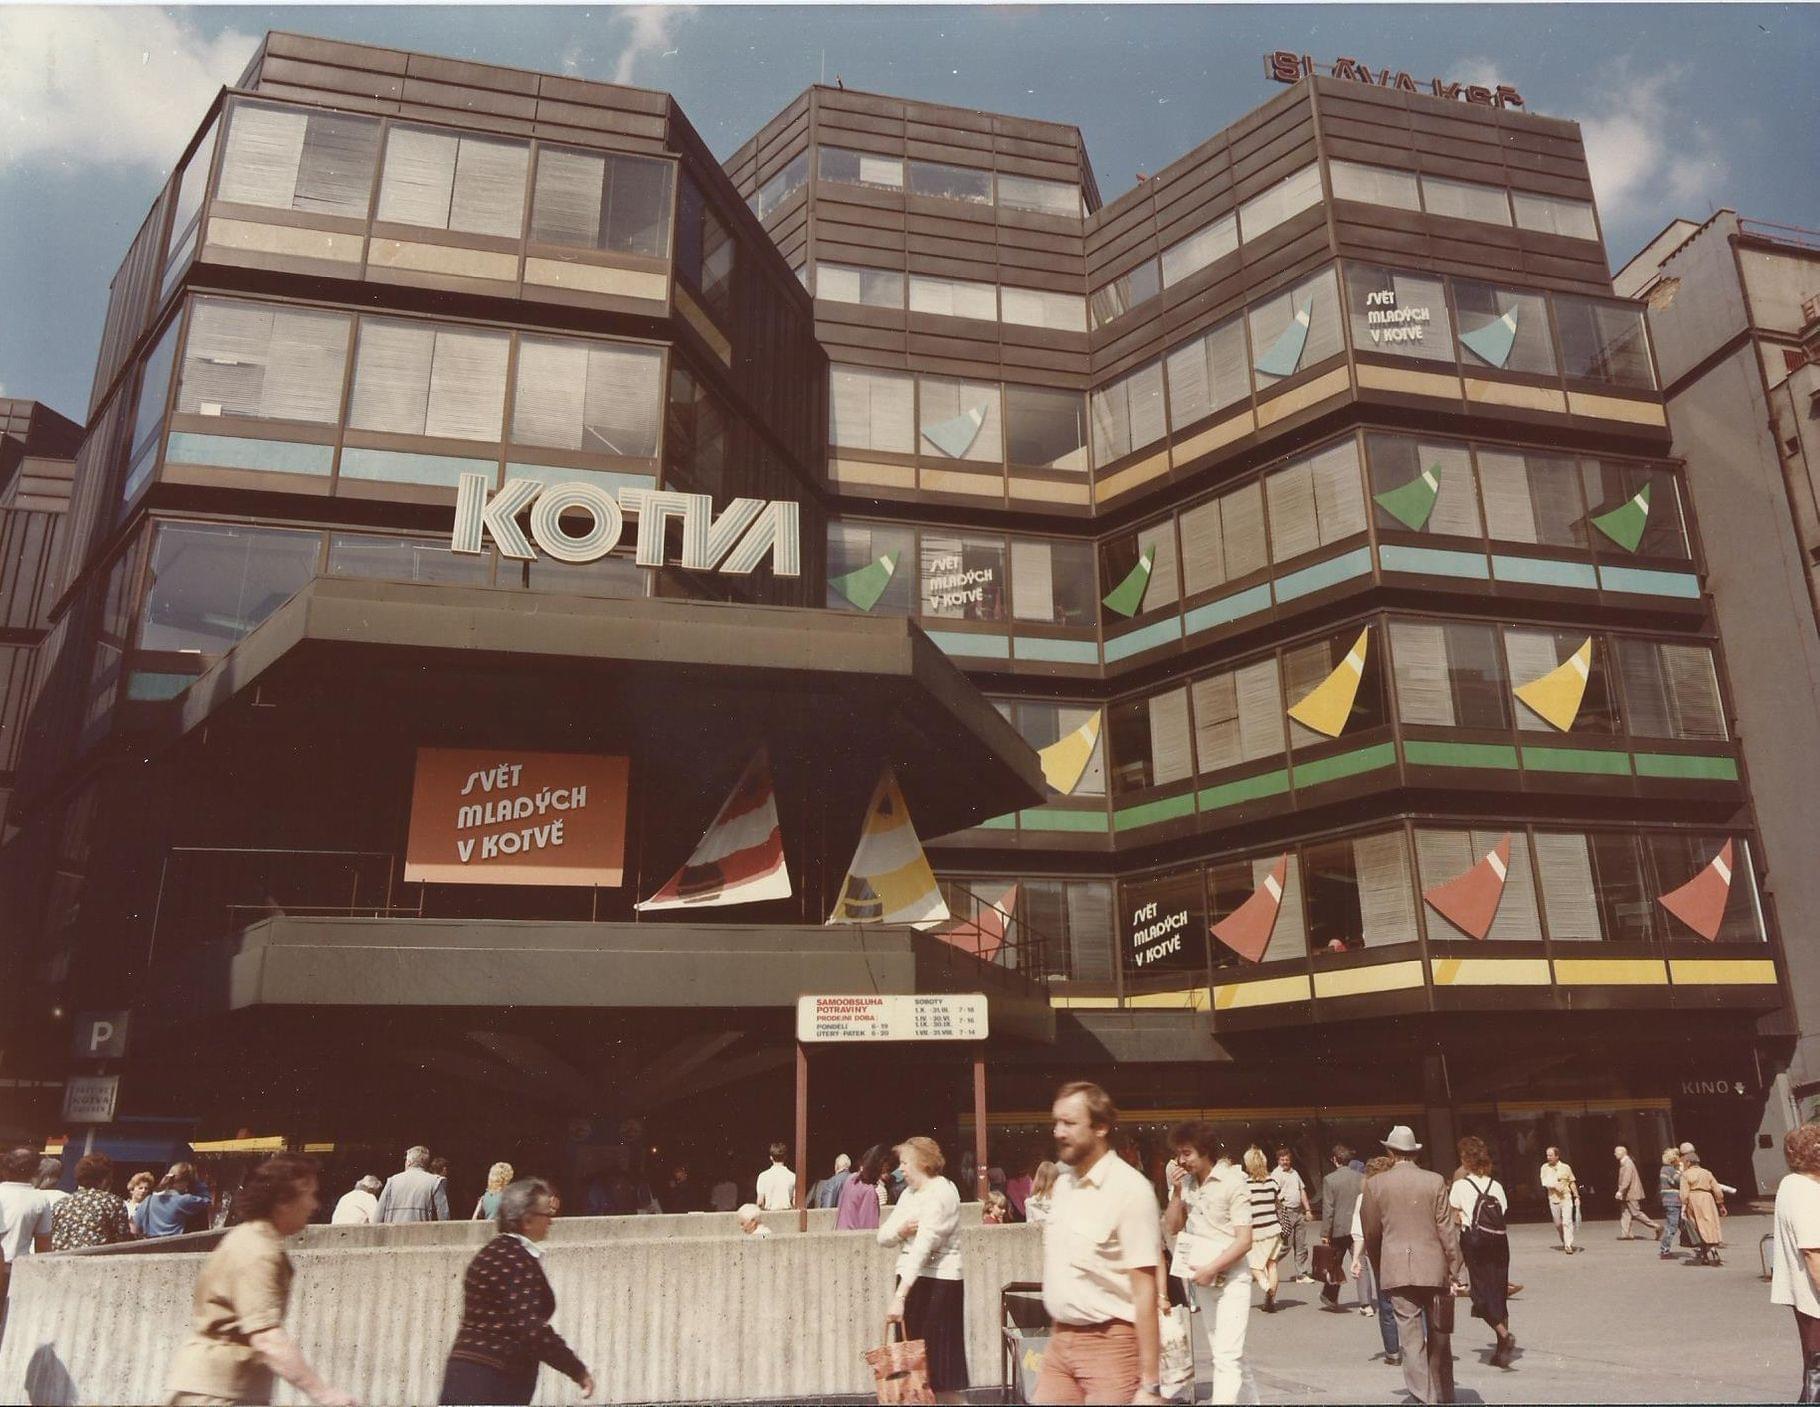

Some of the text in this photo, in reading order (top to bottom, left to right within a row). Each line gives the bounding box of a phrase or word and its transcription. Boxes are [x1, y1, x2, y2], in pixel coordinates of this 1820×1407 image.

[1366, 290, 1394, 306] SVĚT
[1368, 306, 1430, 323] MLADÝCH
[1370, 329, 1380, 342] V
[451, 472, 801, 576] KOTVA
[930, 568, 993, 590] MLADÝCH
[929, 595, 939, 609] V
[461, 762, 523, 795] SVĚT
[457, 785, 588, 829] MLADÝCH
[456, 818, 565, 863] V KOTVĚ
[1133, 902, 1158, 926] SVĚT
[1133, 910, 1188, 947] MLADÝCH
[1135, 932, 1181, 967] V KOTVĚ
[816, 998, 883, 1006] SAMOOBSLUHA
[816, 1006, 867, 1014] POTRAVINY
[90, 1021, 113, 1051] P
[1682, 1080, 1729, 1094] KINO
